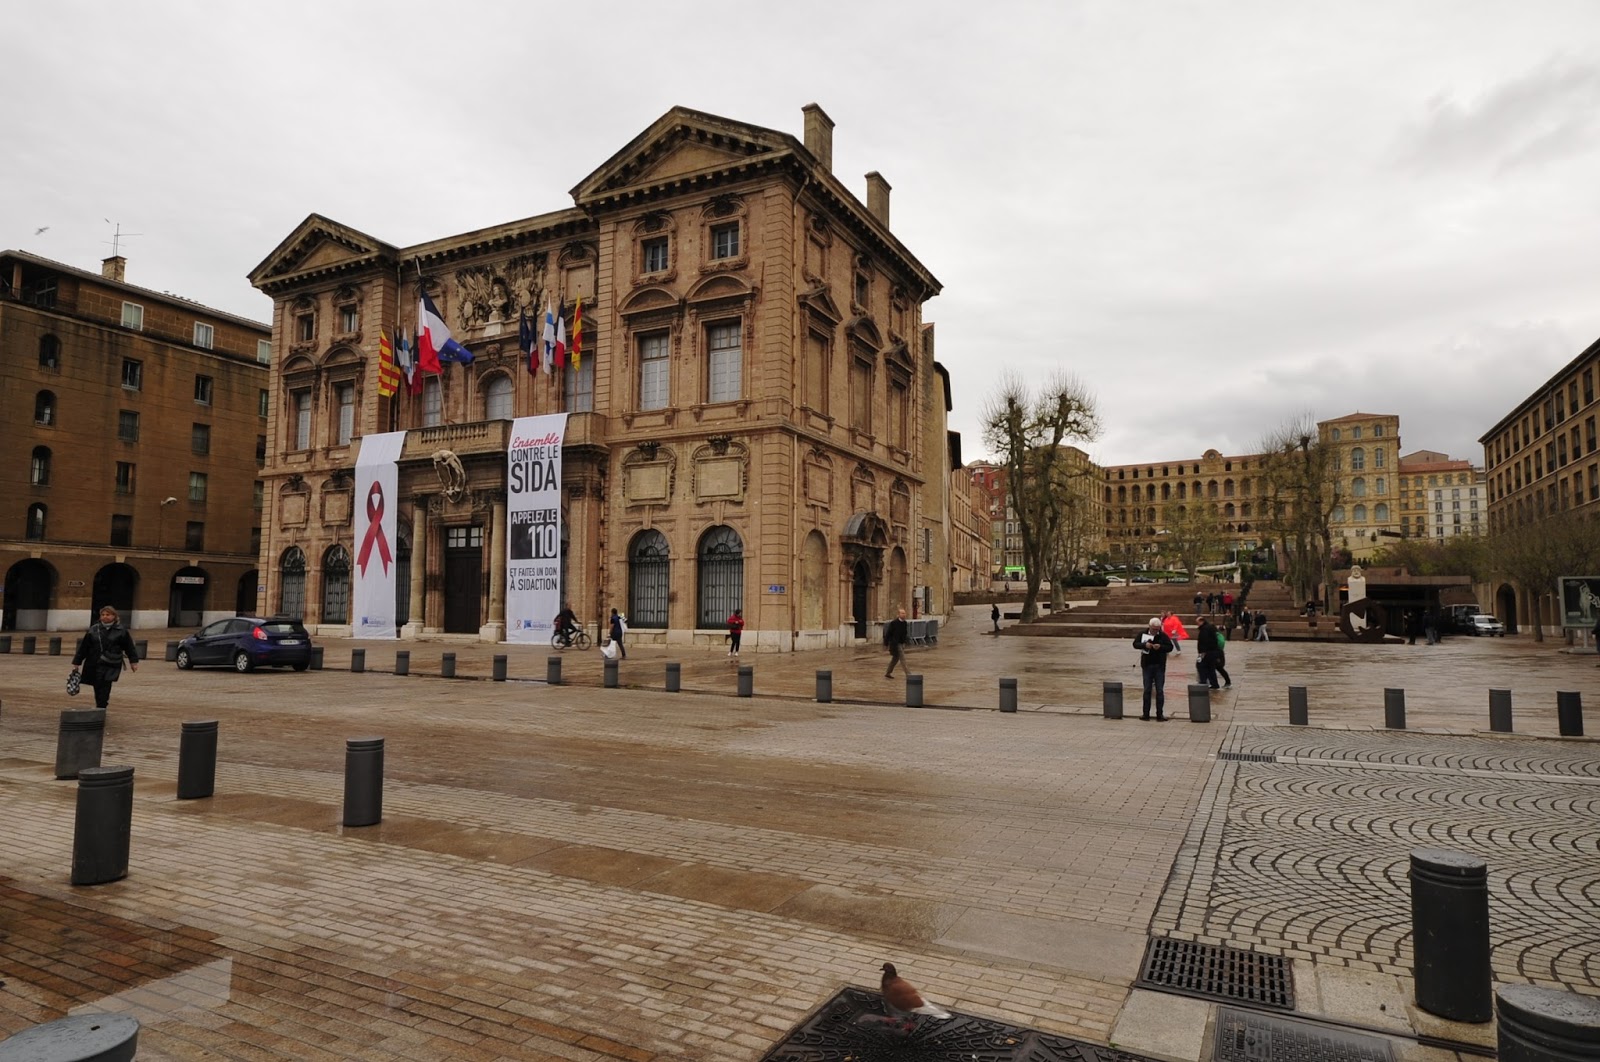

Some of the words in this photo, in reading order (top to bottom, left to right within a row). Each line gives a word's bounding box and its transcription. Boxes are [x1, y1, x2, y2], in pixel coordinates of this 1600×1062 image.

[512, 432, 560, 449] Ensemble
[511, 446, 545, 463] CONTRE
[547, 444, 559, 459] LE
[510, 459, 558, 494] SIDA
[511, 510, 545, 525] APPELEZ
[546, 509, 557, 523] LE
[528, 524, 557, 558] 110
[509, 567, 517, 577] ET
[518, 567, 536, 577] FAITES
[536, 567, 544, 577] UN
[544, 566, 557, 577] DON
[509, 575, 516, 591] À
[517, 578, 558, 591] SIDACTION
